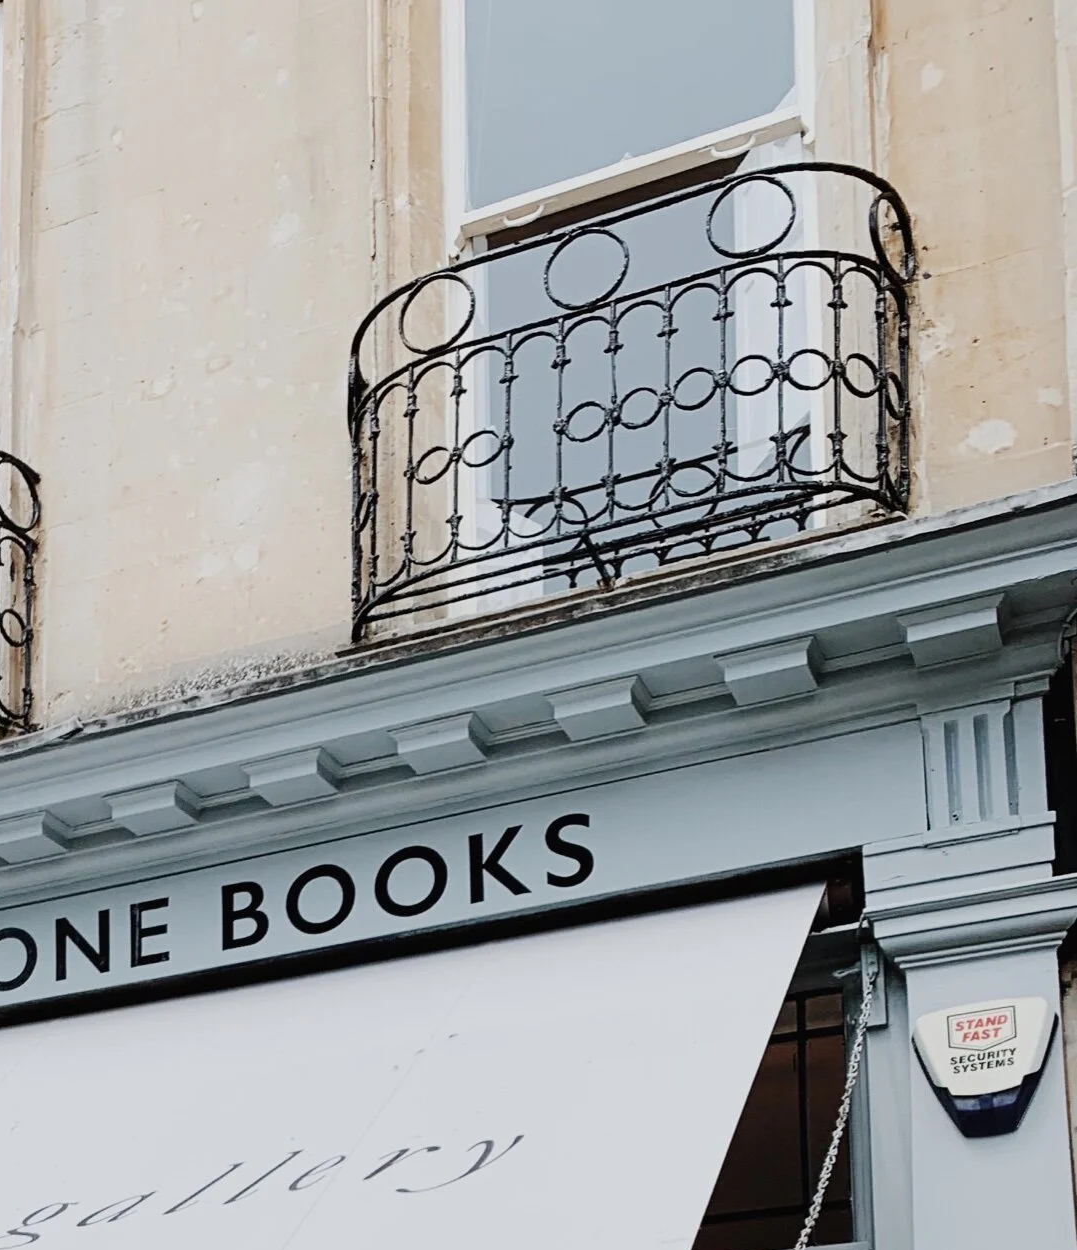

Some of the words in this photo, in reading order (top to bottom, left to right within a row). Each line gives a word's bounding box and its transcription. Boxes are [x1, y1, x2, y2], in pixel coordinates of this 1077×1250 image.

[221, 813, 594, 951] BOOKS
[956, 1015, 1007, 1031] STAND
[962, 1028, 1001, 1042] FAST
[950, 1048, 1016, 1065] SECURITY
[953, 1057, 1015, 1074] SYSTEMS
